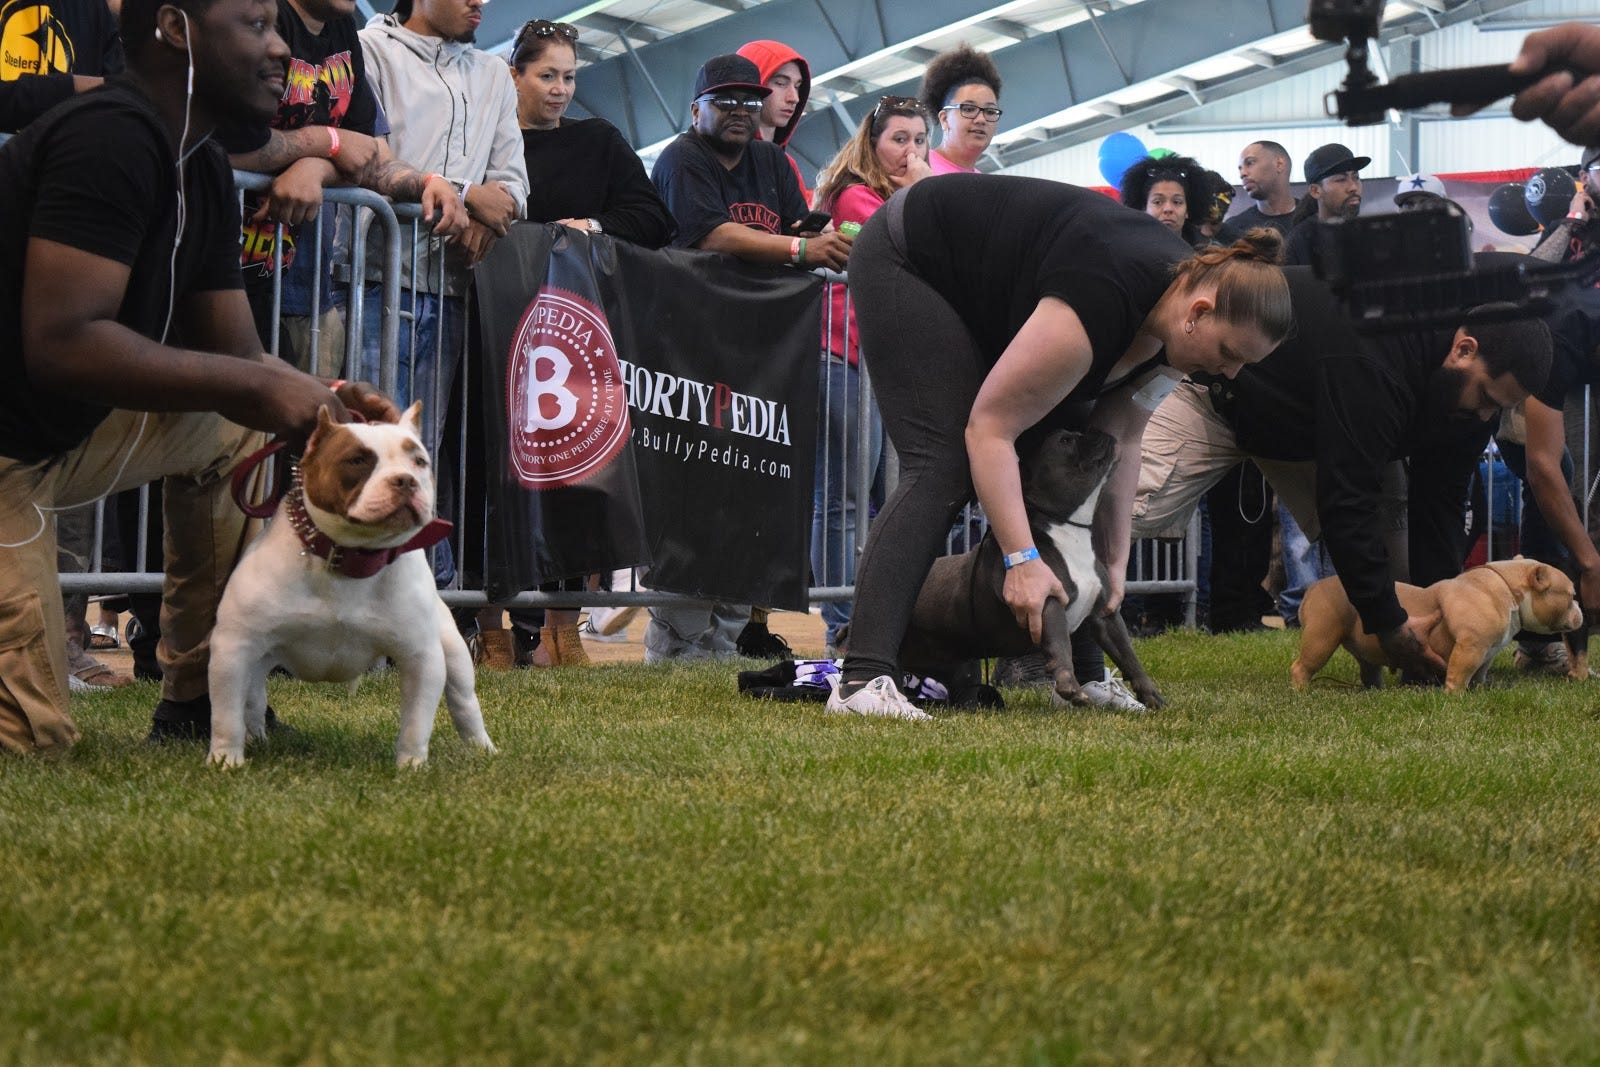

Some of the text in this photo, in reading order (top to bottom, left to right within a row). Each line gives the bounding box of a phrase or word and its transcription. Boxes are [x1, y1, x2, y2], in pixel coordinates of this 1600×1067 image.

[5, 50, 41, 70] Steelers
[526, 306, 593, 353] PEDIA
[524, 345, 580, 434] B
[603, 367, 614, 394] TIME
[603, 402, 613, 418] AT
[619, 359, 792, 446] HORTYPEDIA
[571, 416, 610, 456] PEDIGREE
[631, 427, 792, 479] .BullyPedia.com
[548, 450, 571, 464] ONE
